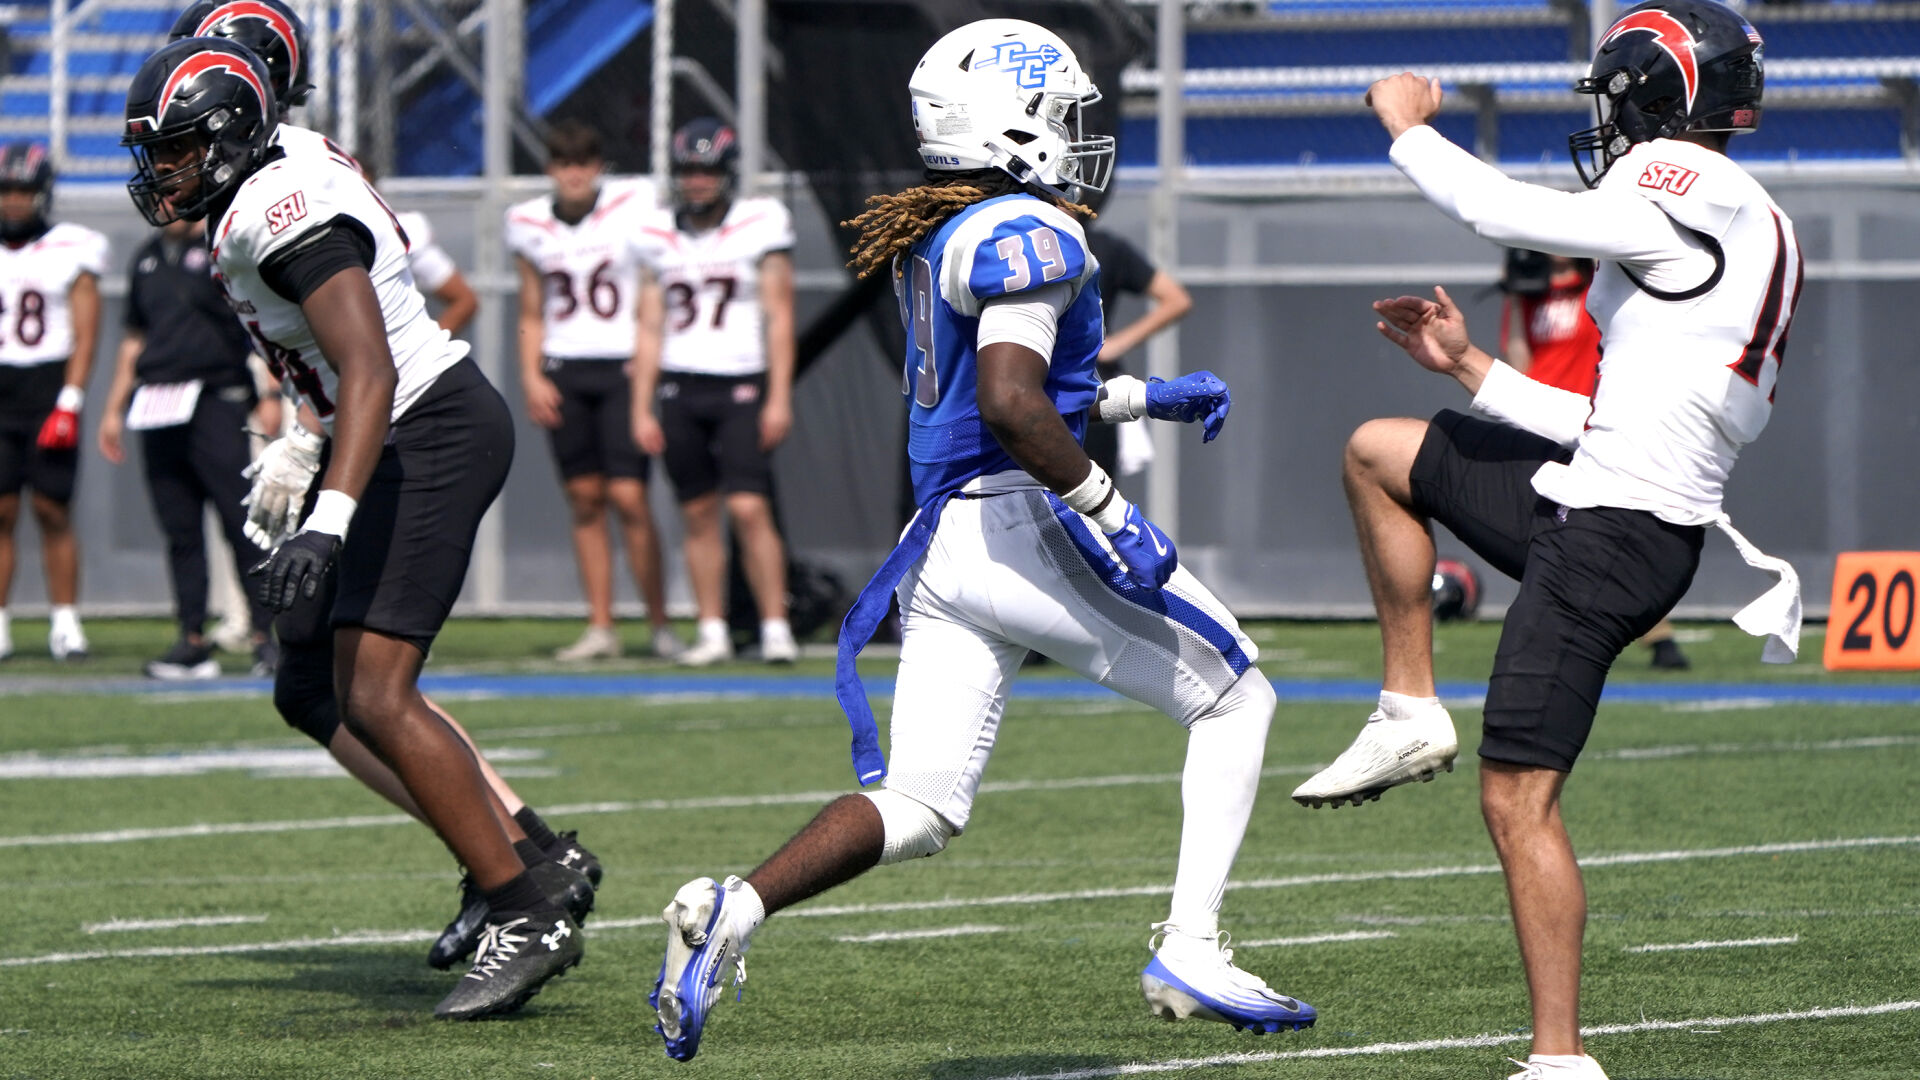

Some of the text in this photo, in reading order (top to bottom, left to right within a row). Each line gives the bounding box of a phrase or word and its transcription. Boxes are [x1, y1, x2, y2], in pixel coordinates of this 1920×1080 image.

[1638, 160, 1700, 196] SFU
[265, 190, 308, 235] SFU
[995, 226, 1067, 293] 39
[0, 289, 46, 347] 8
[543, 258, 621, 322] 36
[664, 275, 739, 332] 37
[1842, 569, 1915, 651] 20
[1398, 741, 1430, 760] ARMOUR
